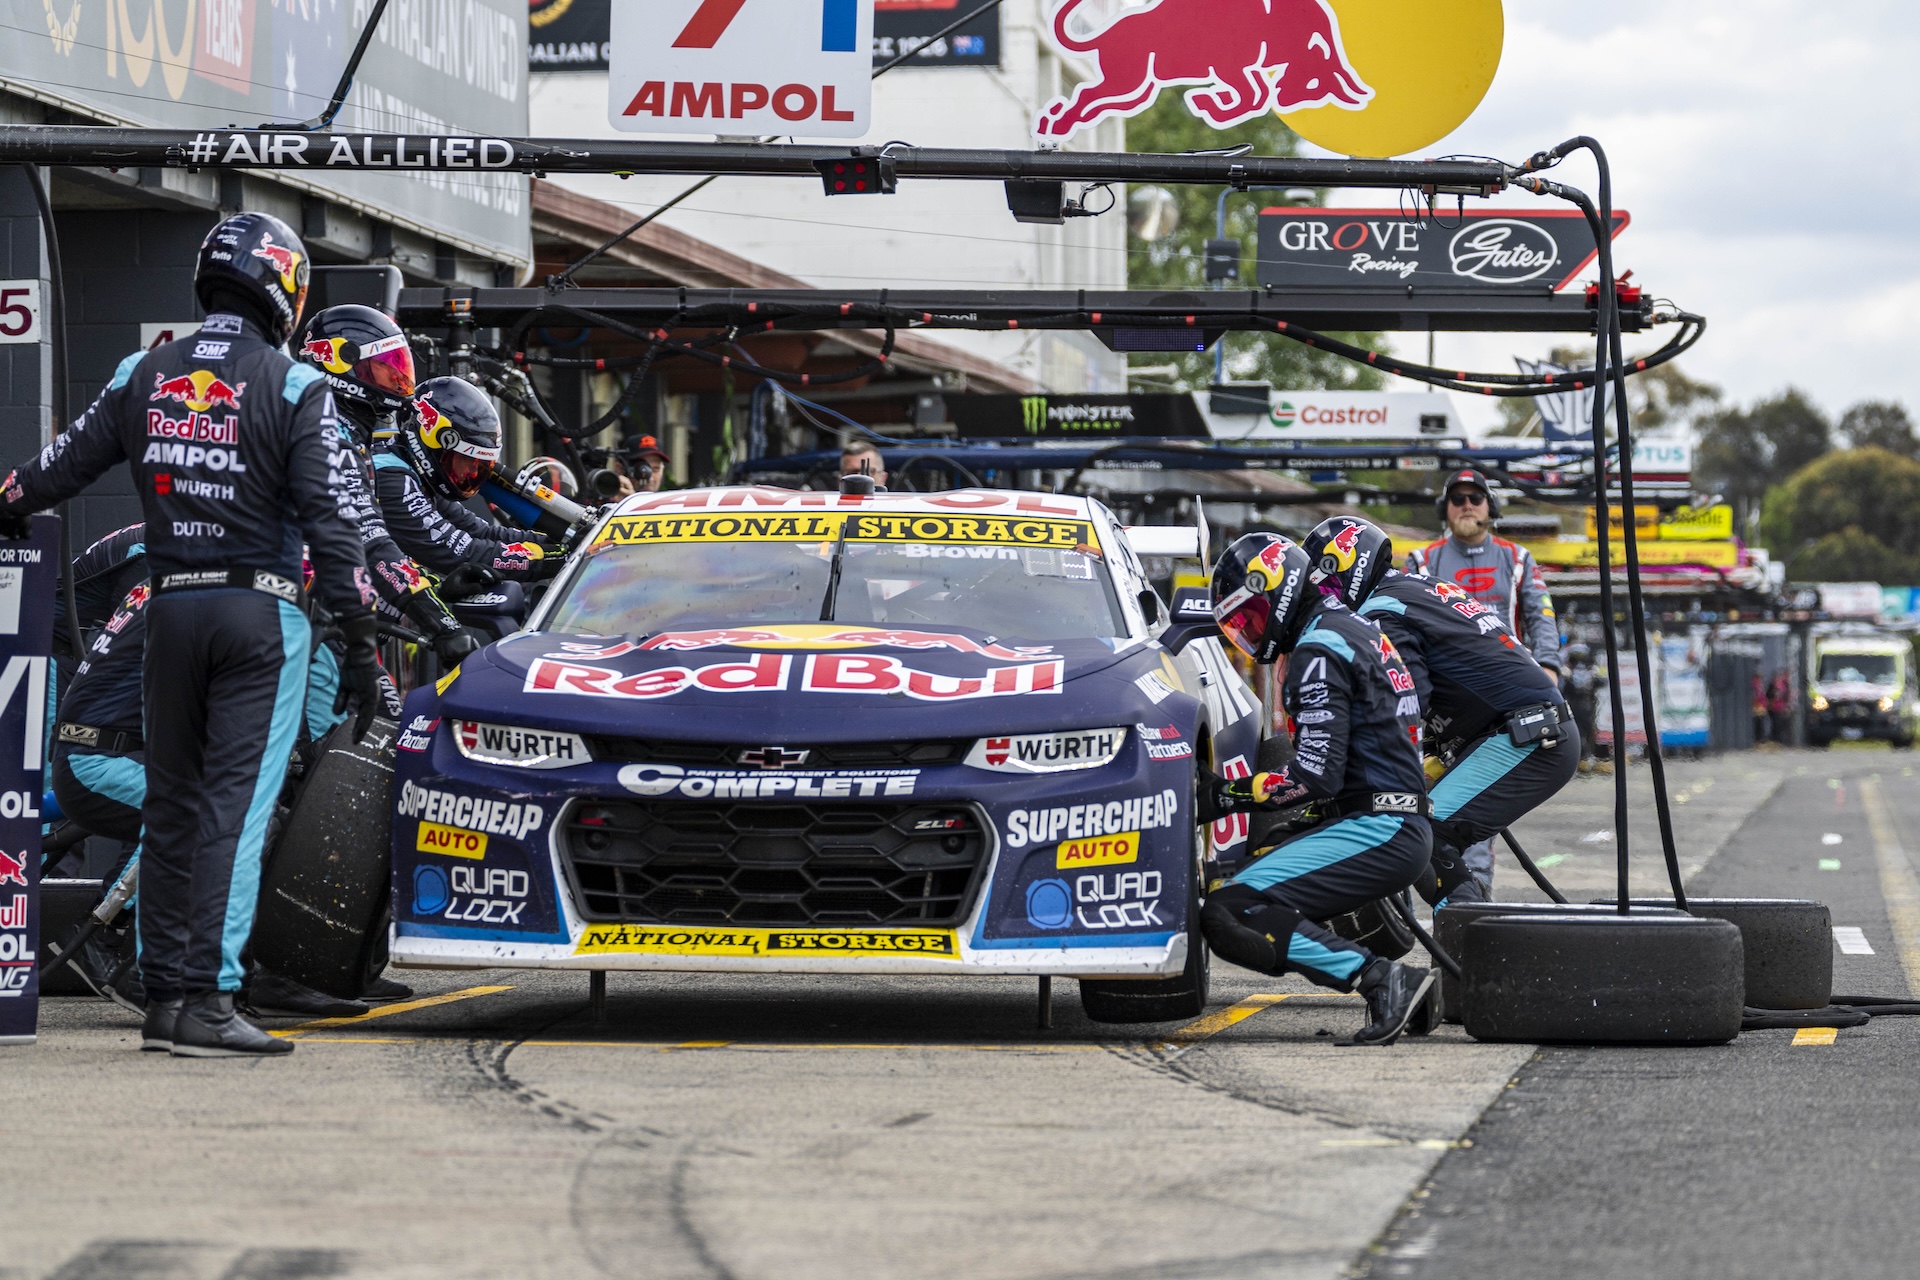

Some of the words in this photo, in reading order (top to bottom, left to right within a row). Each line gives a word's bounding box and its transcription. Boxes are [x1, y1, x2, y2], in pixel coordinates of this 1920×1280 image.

[204, 0, 244, 68] YEARS
[353, 0, 459, 75] STRALIAN
[464, 0, 520, 103] OWNED
[622, 81, 855, 122] AMPOL
[187, 133, 309, 166] #AIR
[329, 136, 515, 169] ALLIED
[1279, 221, 1420, 252] GROVE
[211, 250, 232, 261] Dutto
[1454, 226, 1551, 275] Gates
[1349, 253, 1419, 279] Racing
[0, 288, 32, 337] 5
[194, 343, 230, 357] OMP
[381, 339, 400, 349] AMPOL
[1048, 404, 1135, 421] MONSTER
[1301, 404, 1389, 424] Castrol
[147, 409, 198, 439] Red
[196, 414, 239, 445] Bull
[143, 441, 246, 473] AMPOL
[406, 429, 433, 478] AMPOL
[476, 449, 495, 457] AMPOL
[343, 468, 361, 476] POL
[174, 478, 235, 501] WÜRTH
[173, 521, 225, 538] DUTTO
[607, 517, 833, 543] NATIONAL
[857, 517, 1079, 545] STORAGE
[17, 549, 42, 563] TOM
[493, 557, 511, 570] Red
[511, 558, 529, 570] Bull
[905, 543, 1018, 561] Brown
[171, 572, 200, 581] TRIPLE
[201, 571, 229, 579] EIGHT
[375, 560, 392, 582] Red
[390, 576, 408, 595] Bull
[1347, 550, 1372, 602] AMPOL
[462, 592, 508, 605] elco
[1222, 593, 1243, 611] AMPOL
[1275, 567, 1301, 624] AMPOL
[523, 653, 792, 701] Red
[801, 653, 1065, 701] Bull
[481, 727, 574, 760] WÜRTH
[1136, 723, 1162, 740] Shaw
[1160, 723, 1181, 739] and
[1016, 735, 1114, 761] WÜRTH
[1144, 741, 1192, 758] Partners
[617, 763, 918, 798] COMPLETE
[837, 768, 922, 777] SOLUTIONS
[398, 779, 544, 841] SUPERCHEAP
[1006, 789, 1178, 849] SUPERCHEAP
[423, 828, 480, 852] AUTO
[1064, 839, 1130, 861] AUTO
[450, 866, 529, 898] QUAD
[1076, 870, 1162, 902] QUAD
[444, 896, 527, 925] LOCK
[1077, 899, 1163, 929] LOCK
[585, 930, 757, 948] NATIONAL
[778, 933, 945, 952] STORAGE
